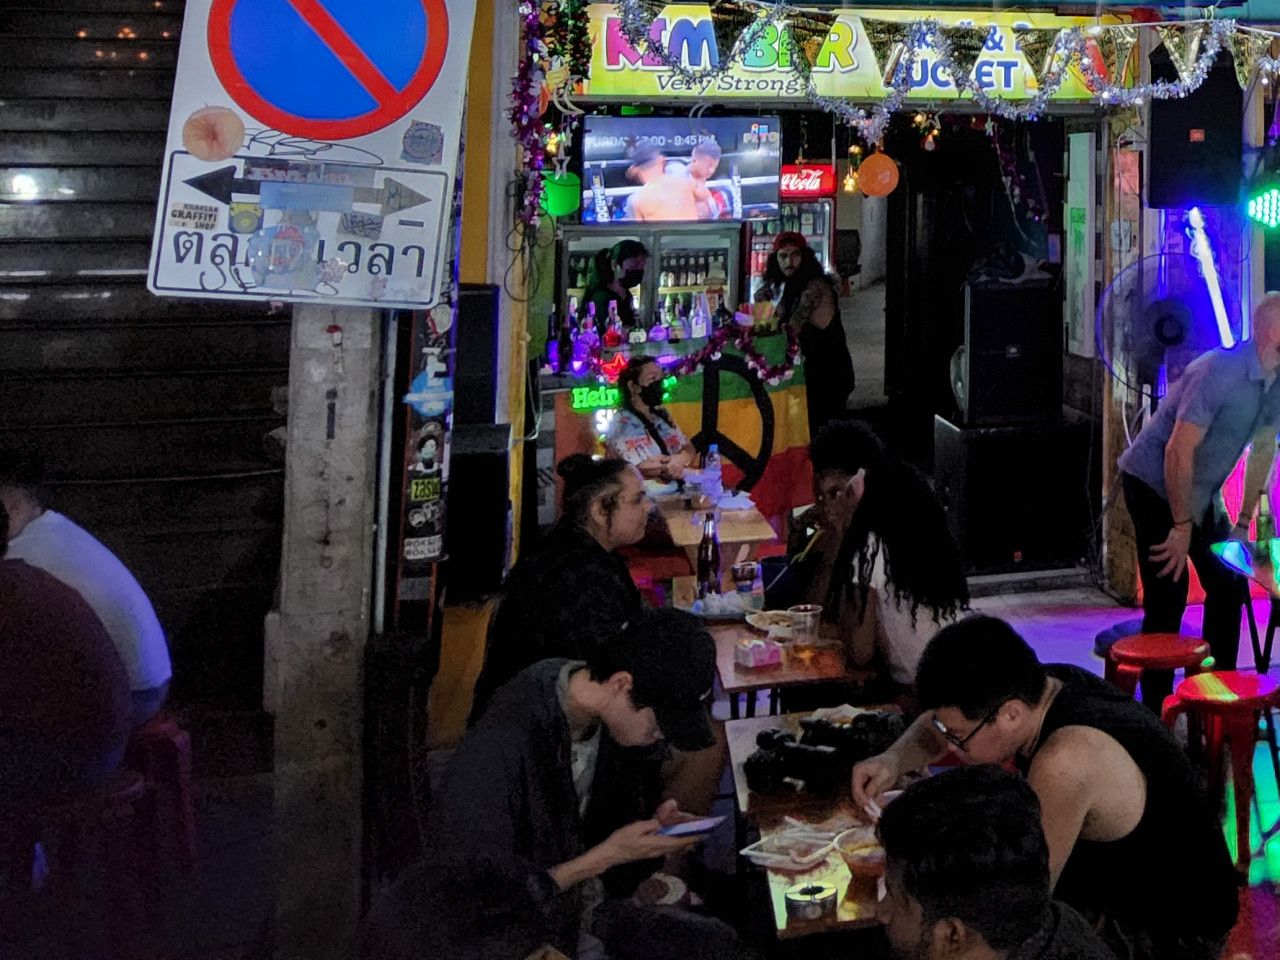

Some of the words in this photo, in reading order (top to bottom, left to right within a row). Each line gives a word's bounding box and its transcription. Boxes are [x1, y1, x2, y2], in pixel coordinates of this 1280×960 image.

[656, 74, 712, 94] Very
[717, 73, 800, 95] Strong
[171, 209, 218, 222] GRAFFITI
[172, 230, 426, 278] ตลเวลา
